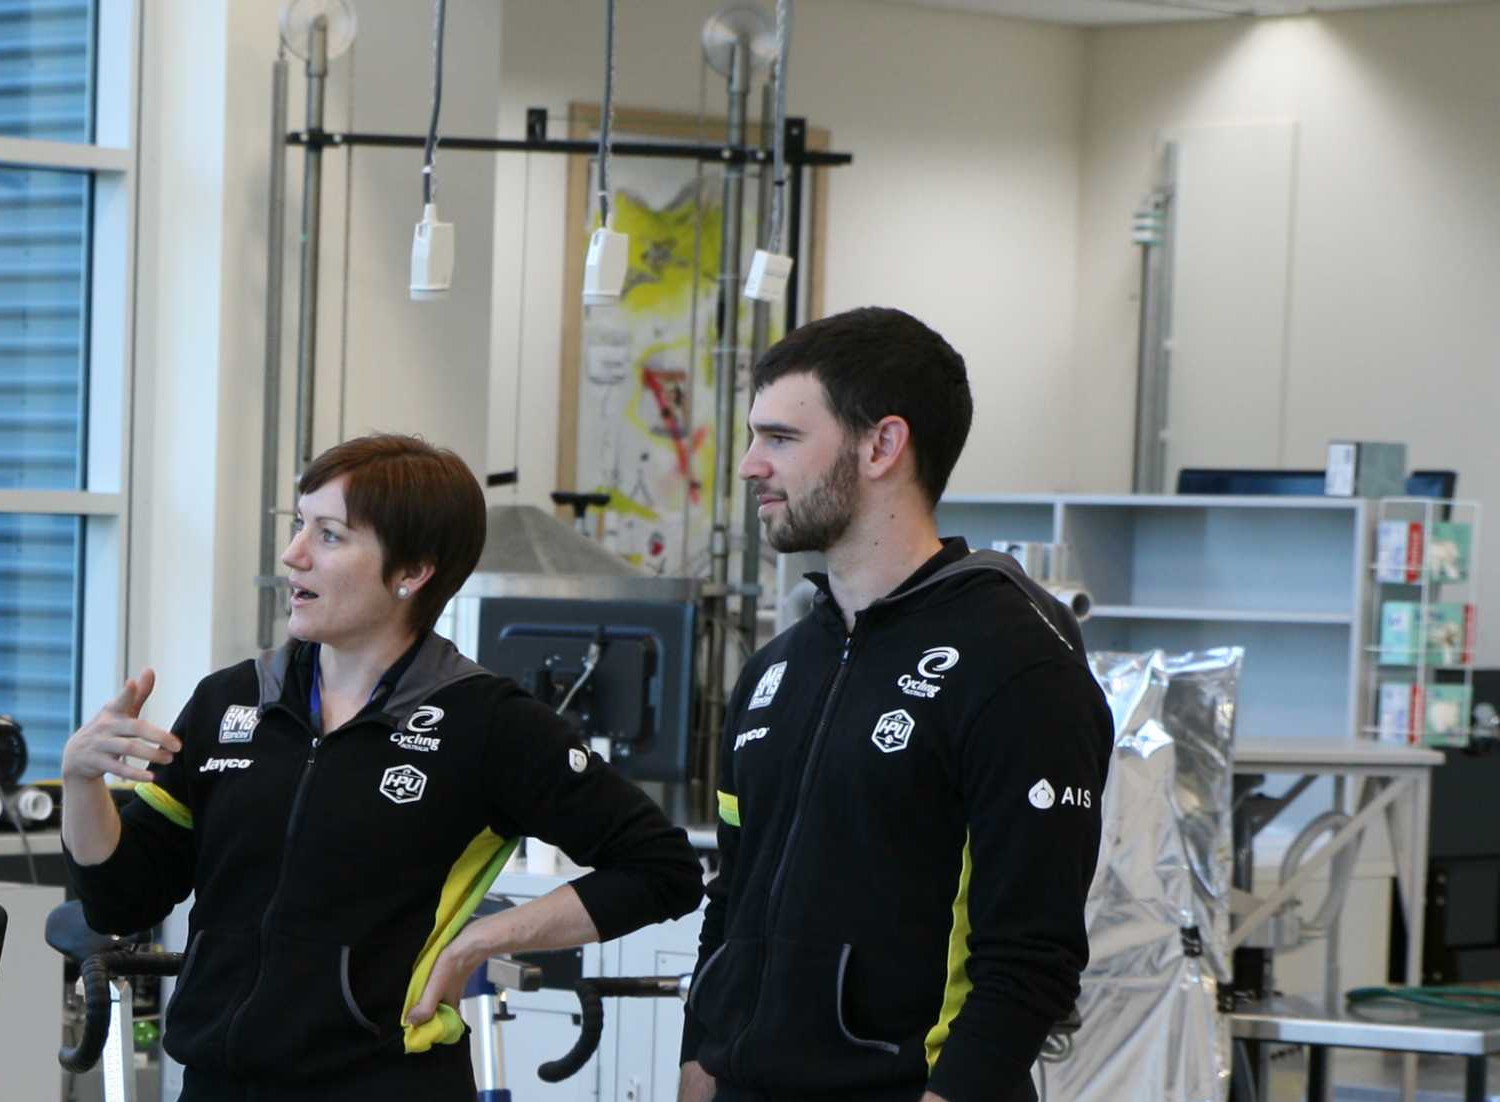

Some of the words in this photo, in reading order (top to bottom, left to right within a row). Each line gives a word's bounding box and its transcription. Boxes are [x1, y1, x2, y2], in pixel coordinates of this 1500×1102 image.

[897, 674, 941, 698] Cycling
[878, 719, 909, 739] HPU
[390, 732, 441, 751] Cycling
[199, 757, 252, 772] Jayco
[385, 774, 421, 793] HPU
[1061, 786, 1092, 808] AIS
